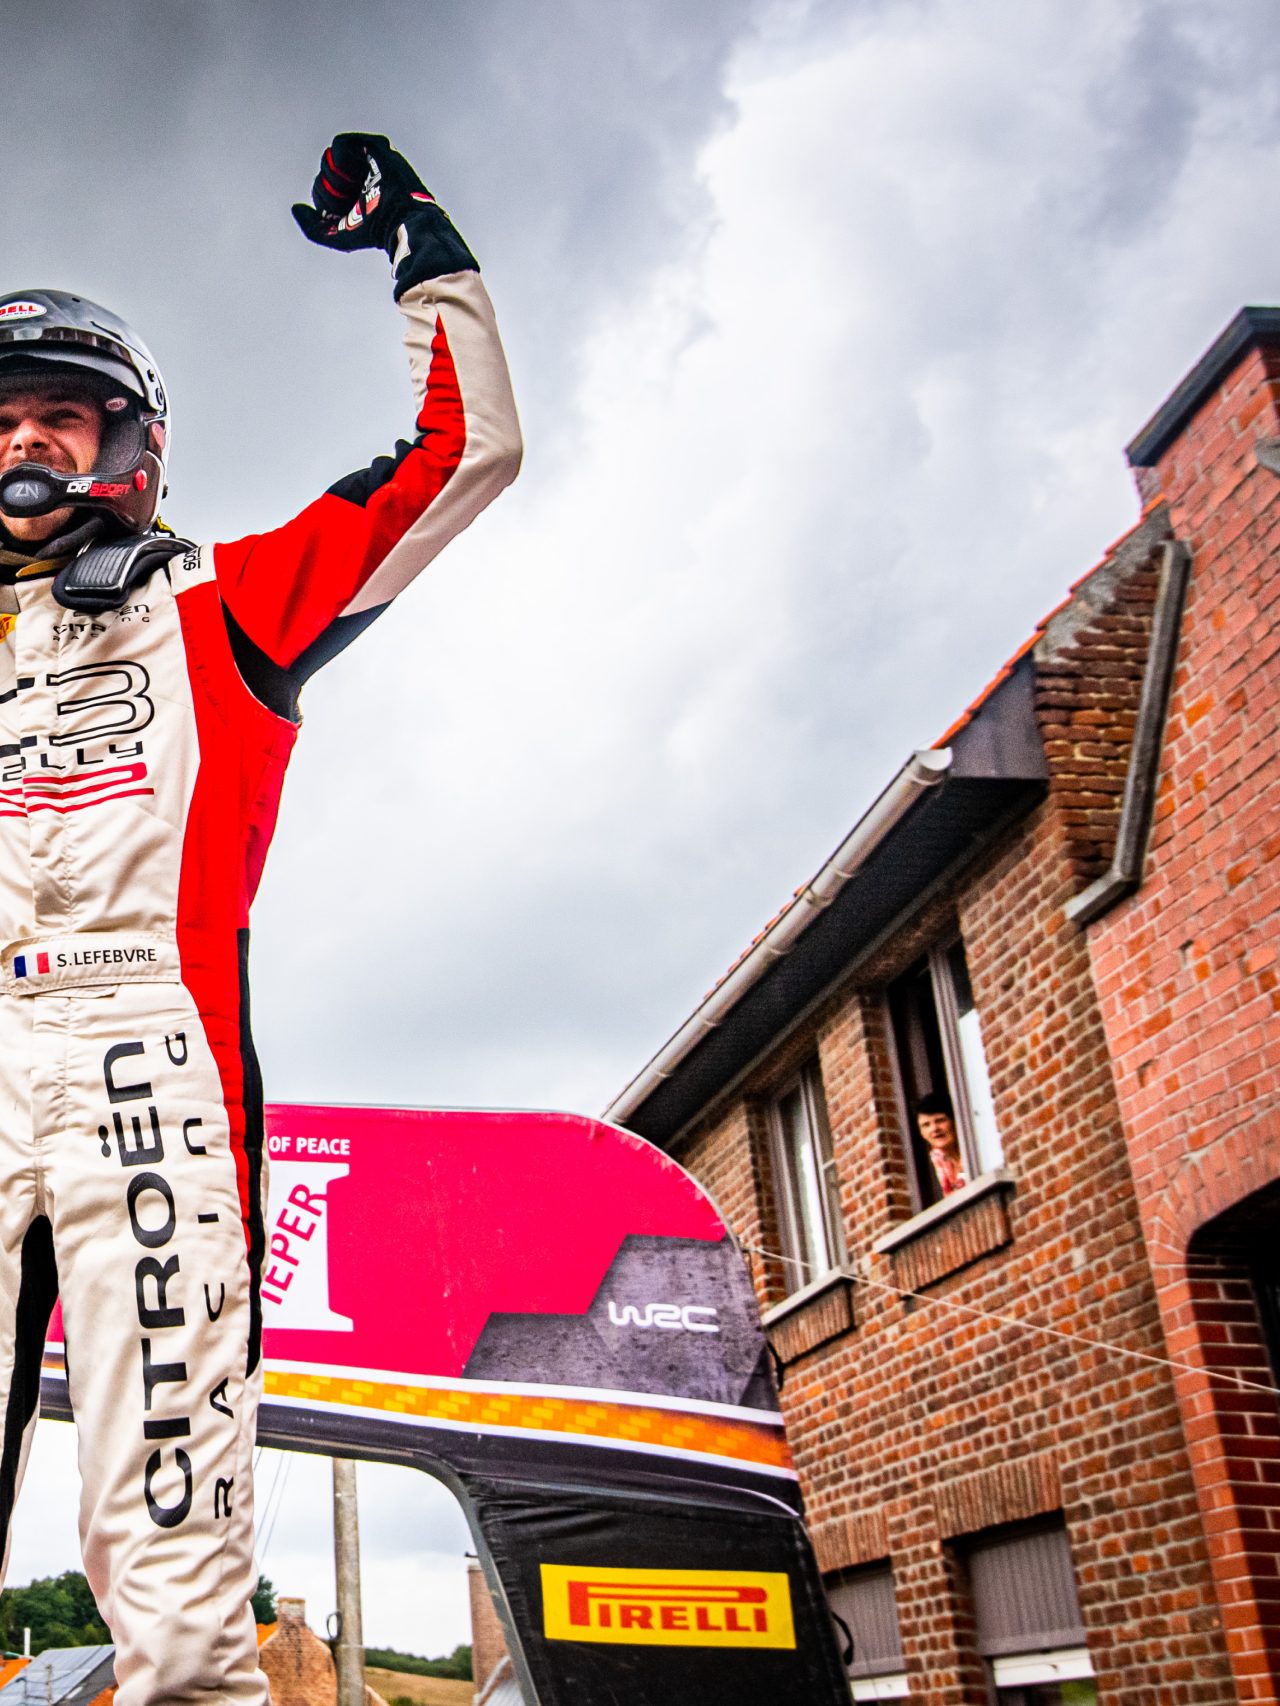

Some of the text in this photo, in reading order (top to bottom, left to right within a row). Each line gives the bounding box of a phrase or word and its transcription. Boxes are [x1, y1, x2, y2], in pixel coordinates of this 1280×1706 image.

[89, 483, 132, 497] SPORT
[268, 1135, 351, 1156] OF PEACE
[260, 1183, 327, 1306] IEPER
[608, 1301, 719, 1332] WRC
[567, 1580, 769, 1633] PIRELLI
